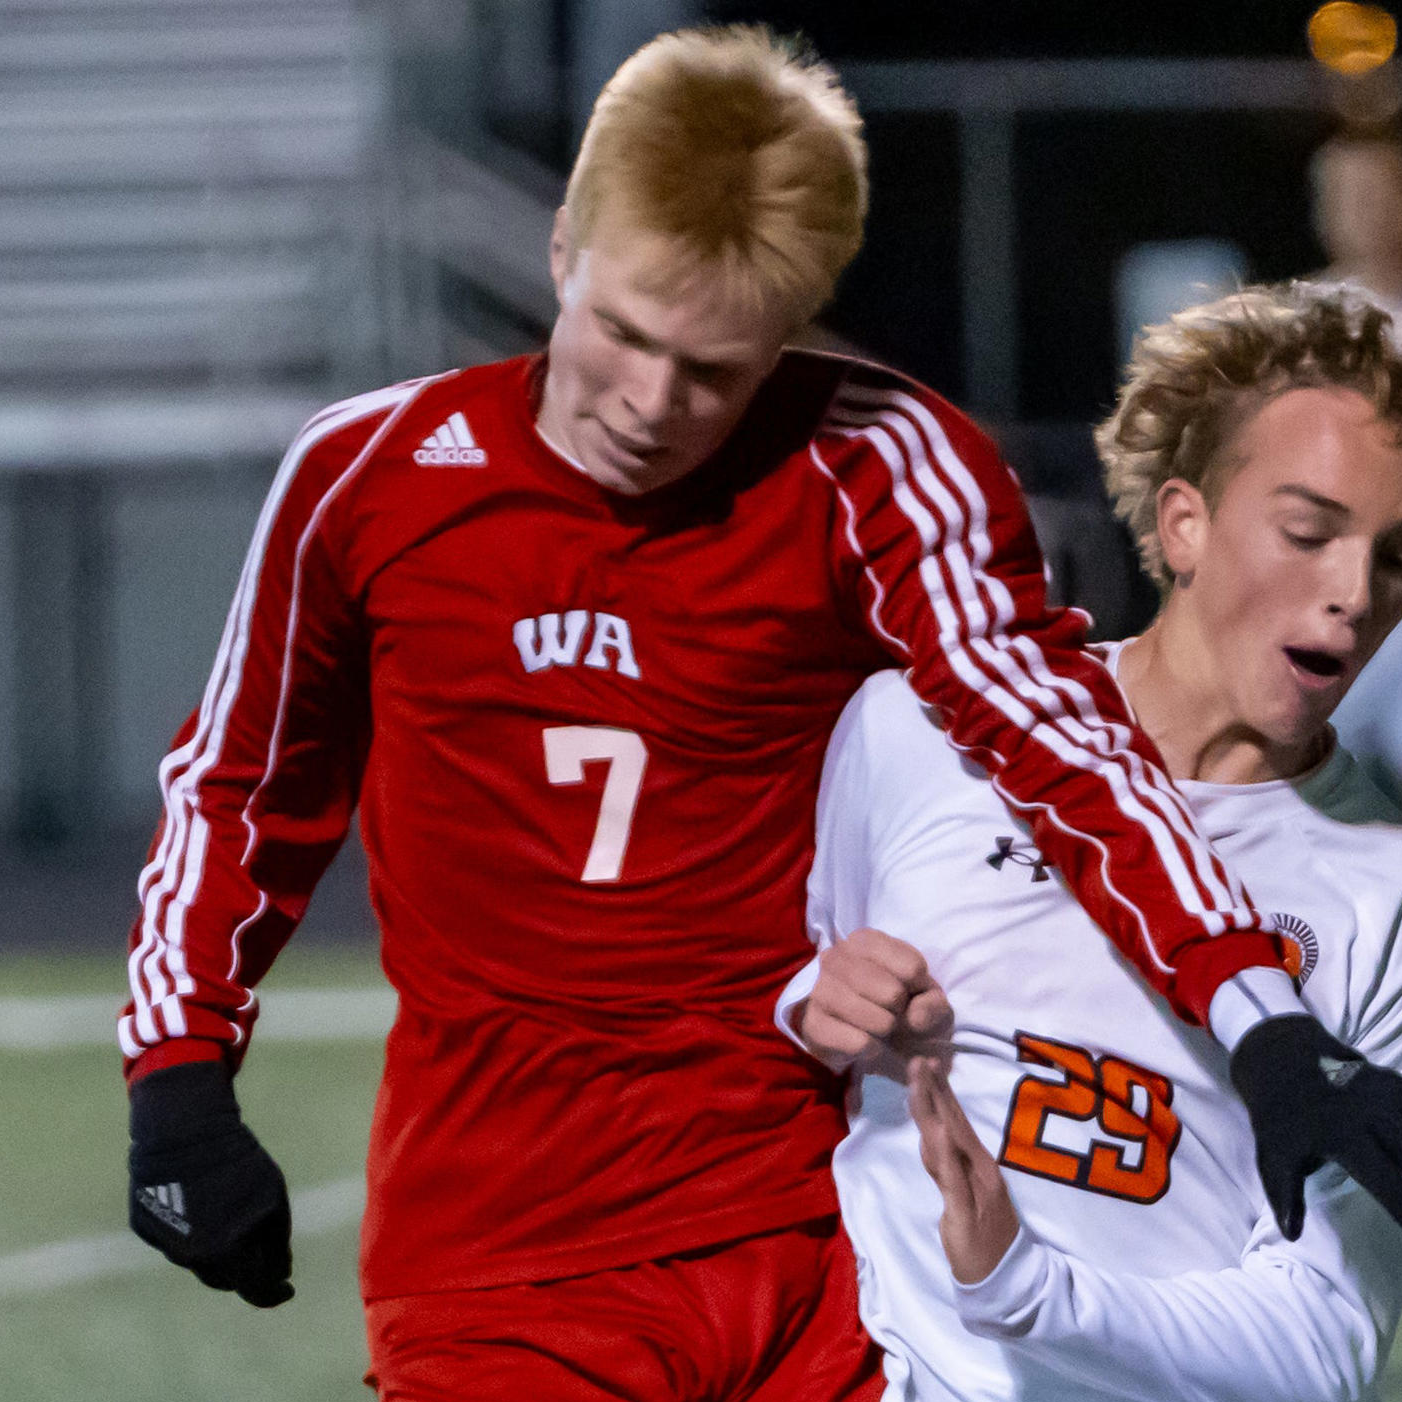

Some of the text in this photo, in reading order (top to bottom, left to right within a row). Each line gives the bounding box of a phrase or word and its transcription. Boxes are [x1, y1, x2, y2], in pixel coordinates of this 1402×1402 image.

[412, 449, 486, 465] adidas
[513, 609, 642, 680] WA
[542, 725, 648, 882] 7
[998, 1029, 1182, 1205] 29
